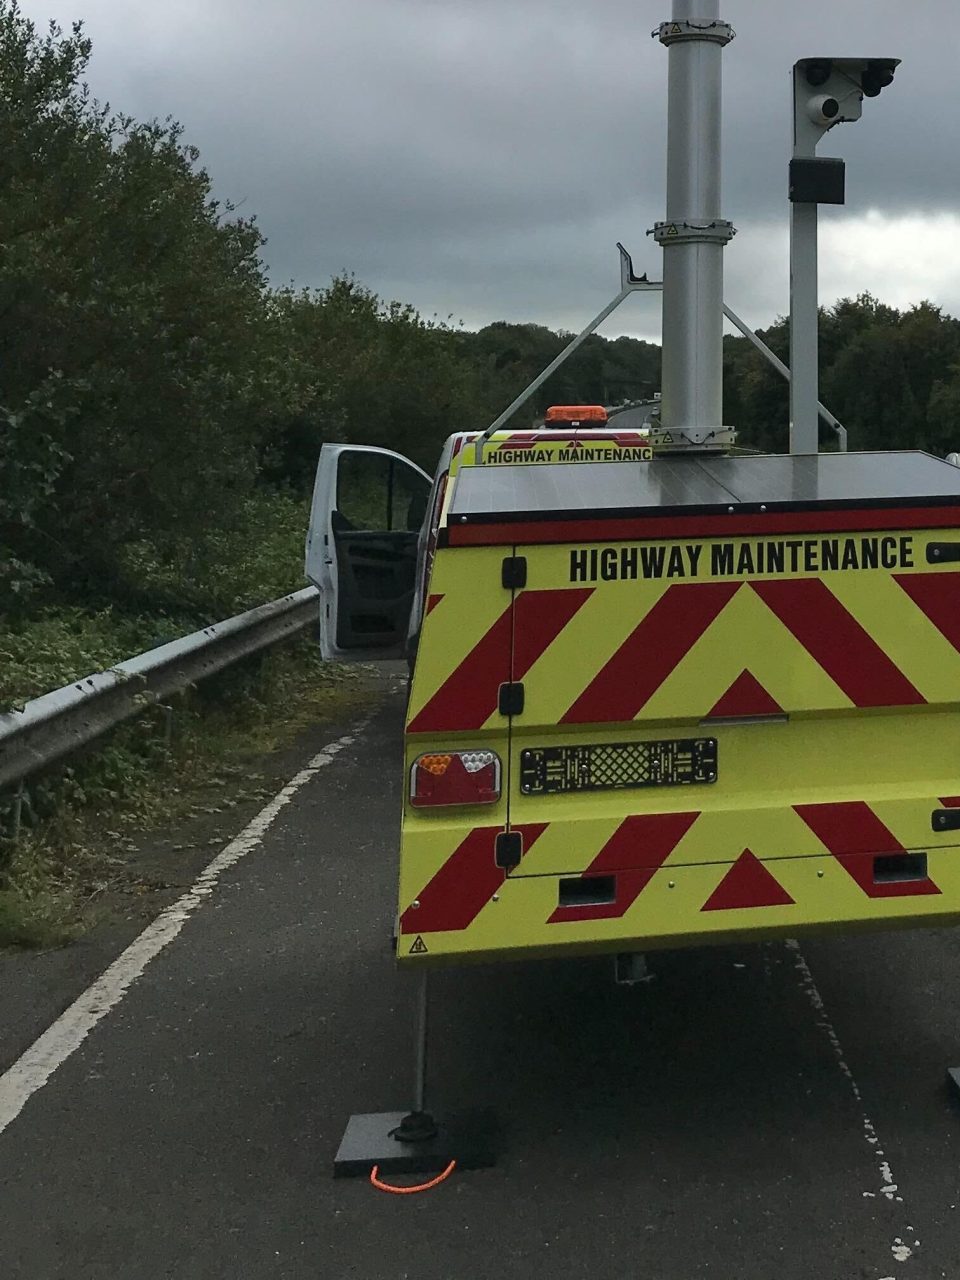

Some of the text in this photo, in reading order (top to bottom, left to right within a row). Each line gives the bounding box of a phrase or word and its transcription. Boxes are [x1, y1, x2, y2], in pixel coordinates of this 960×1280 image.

[487, 448, 654, 464] HIGHWAY MAINTENANC
[569, 536, 914, 582] HIGHWAY MAINTENANCE
